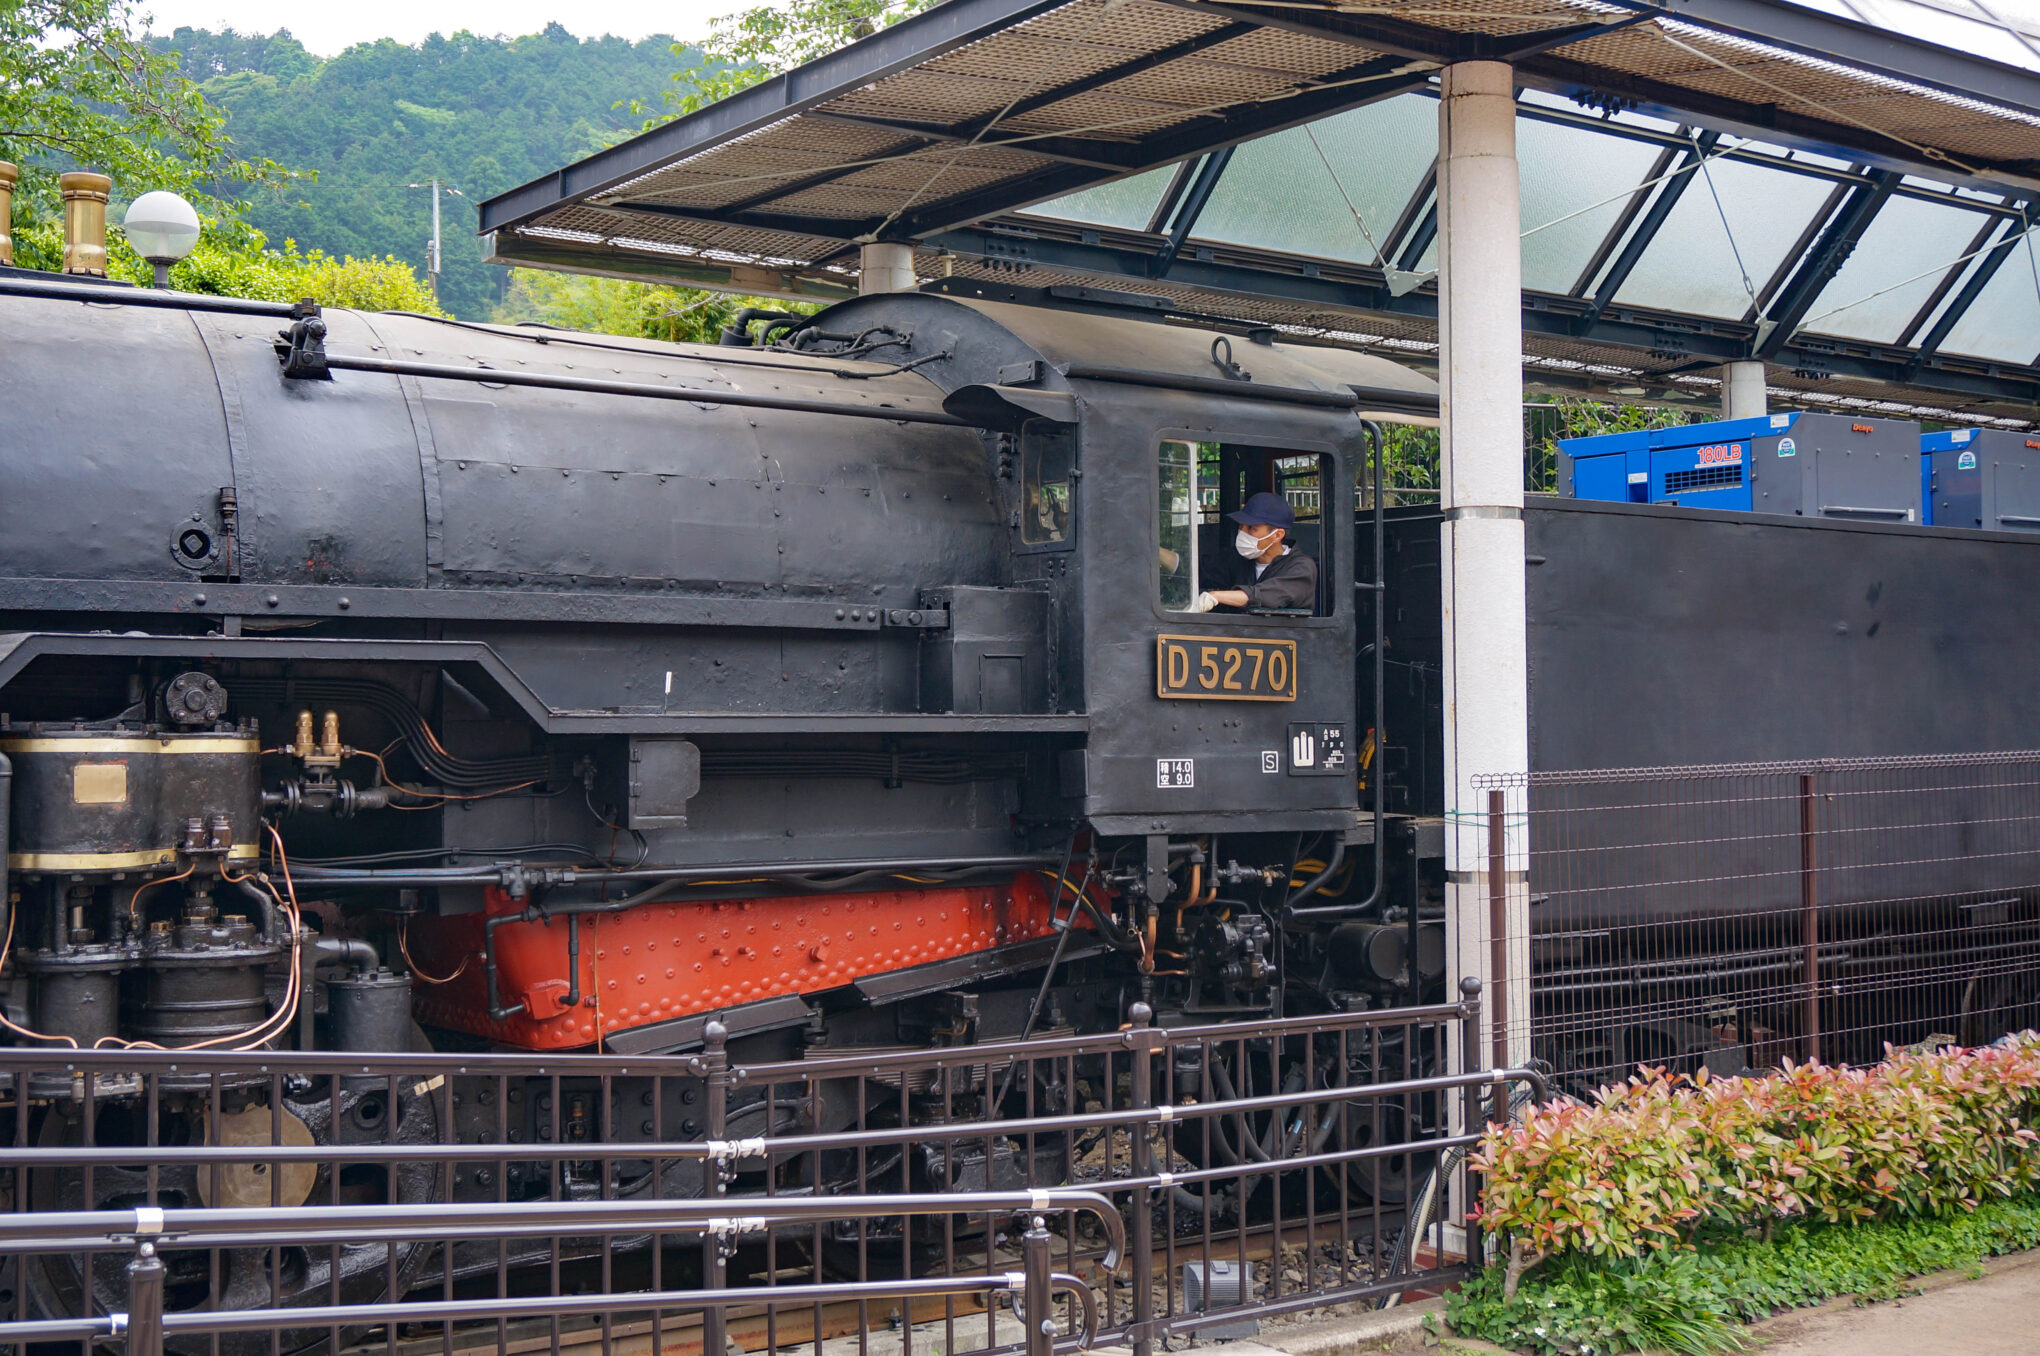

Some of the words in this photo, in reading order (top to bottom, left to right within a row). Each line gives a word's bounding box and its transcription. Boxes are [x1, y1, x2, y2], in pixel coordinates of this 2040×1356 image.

[1697, 444, 1742, 464] 180LB
[1172, 761, 1191, 773] 14.0
[1265, 756, 1275, 769] S
[1176, 773, 1191, 785] 9.0
